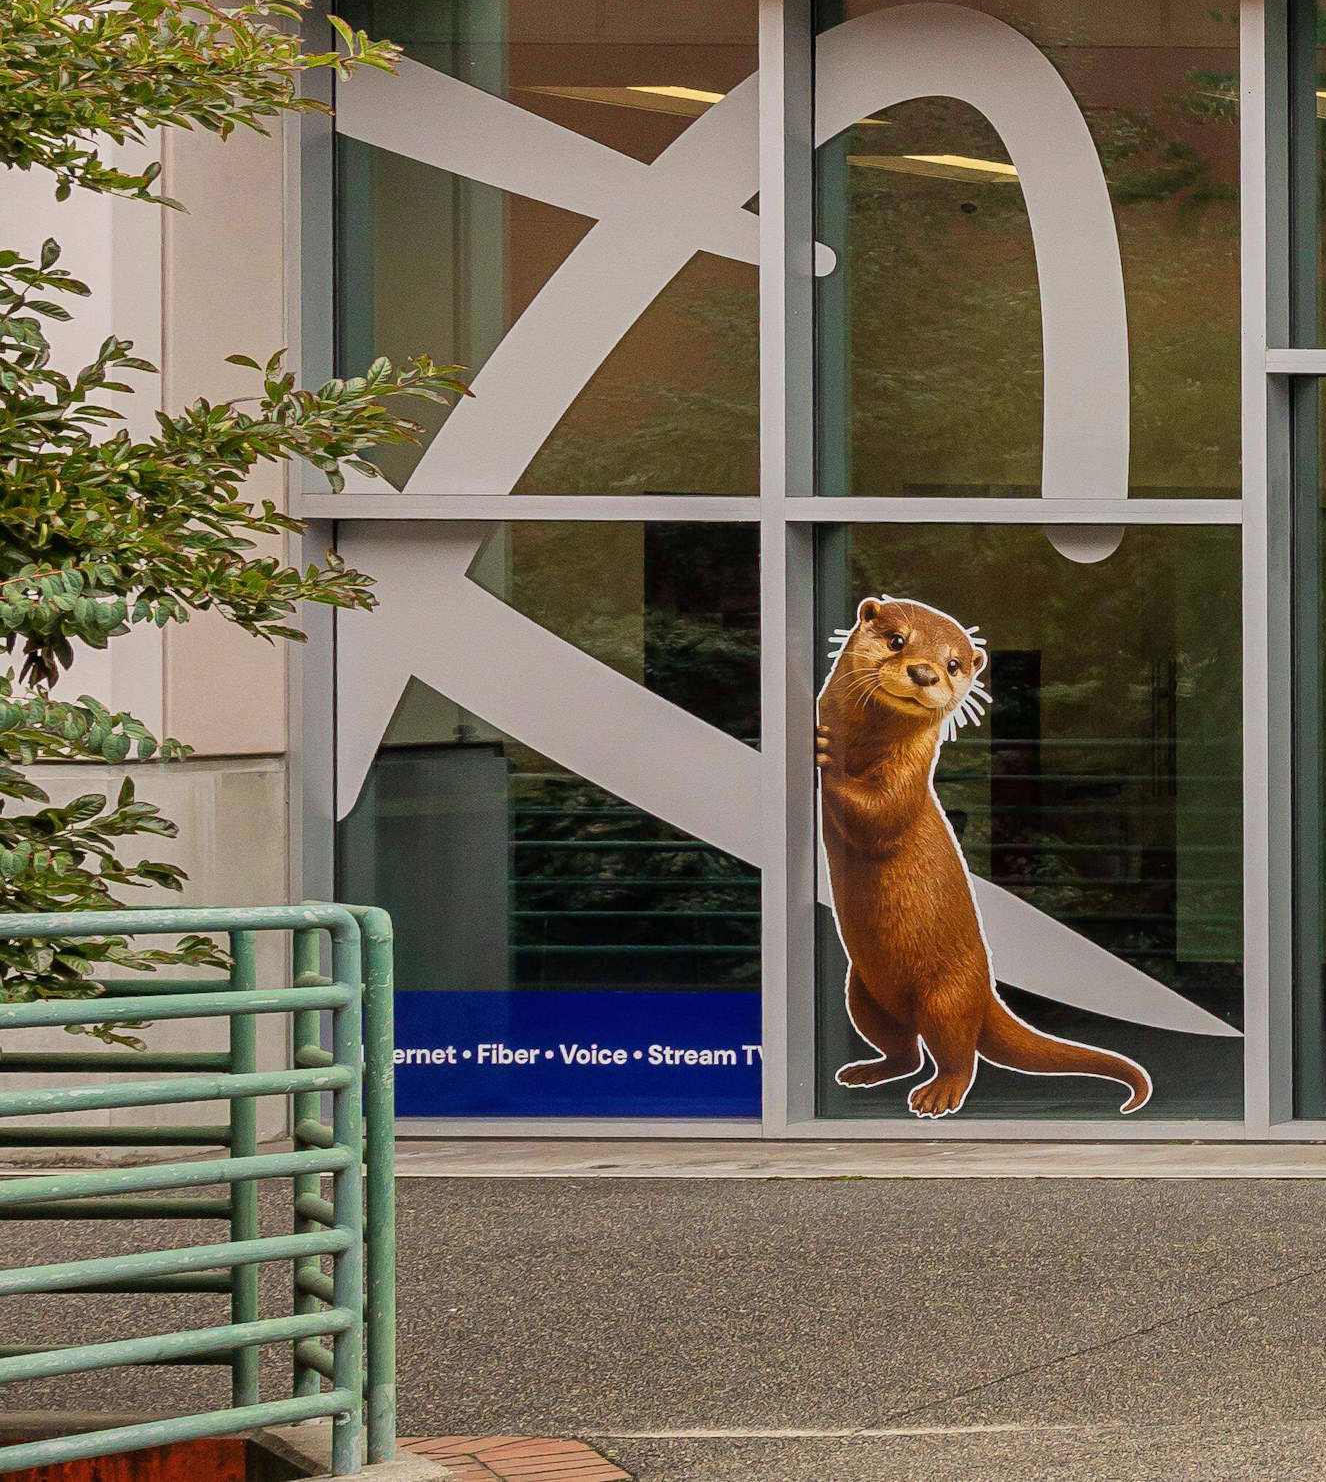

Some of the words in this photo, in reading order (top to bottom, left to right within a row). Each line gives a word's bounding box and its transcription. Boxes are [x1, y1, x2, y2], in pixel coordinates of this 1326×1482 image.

[477, 1044, 540, 1065] Fiber
[559, 1044, 628, 1065] Voice
[648, 1044, 737, 1065] Stream
